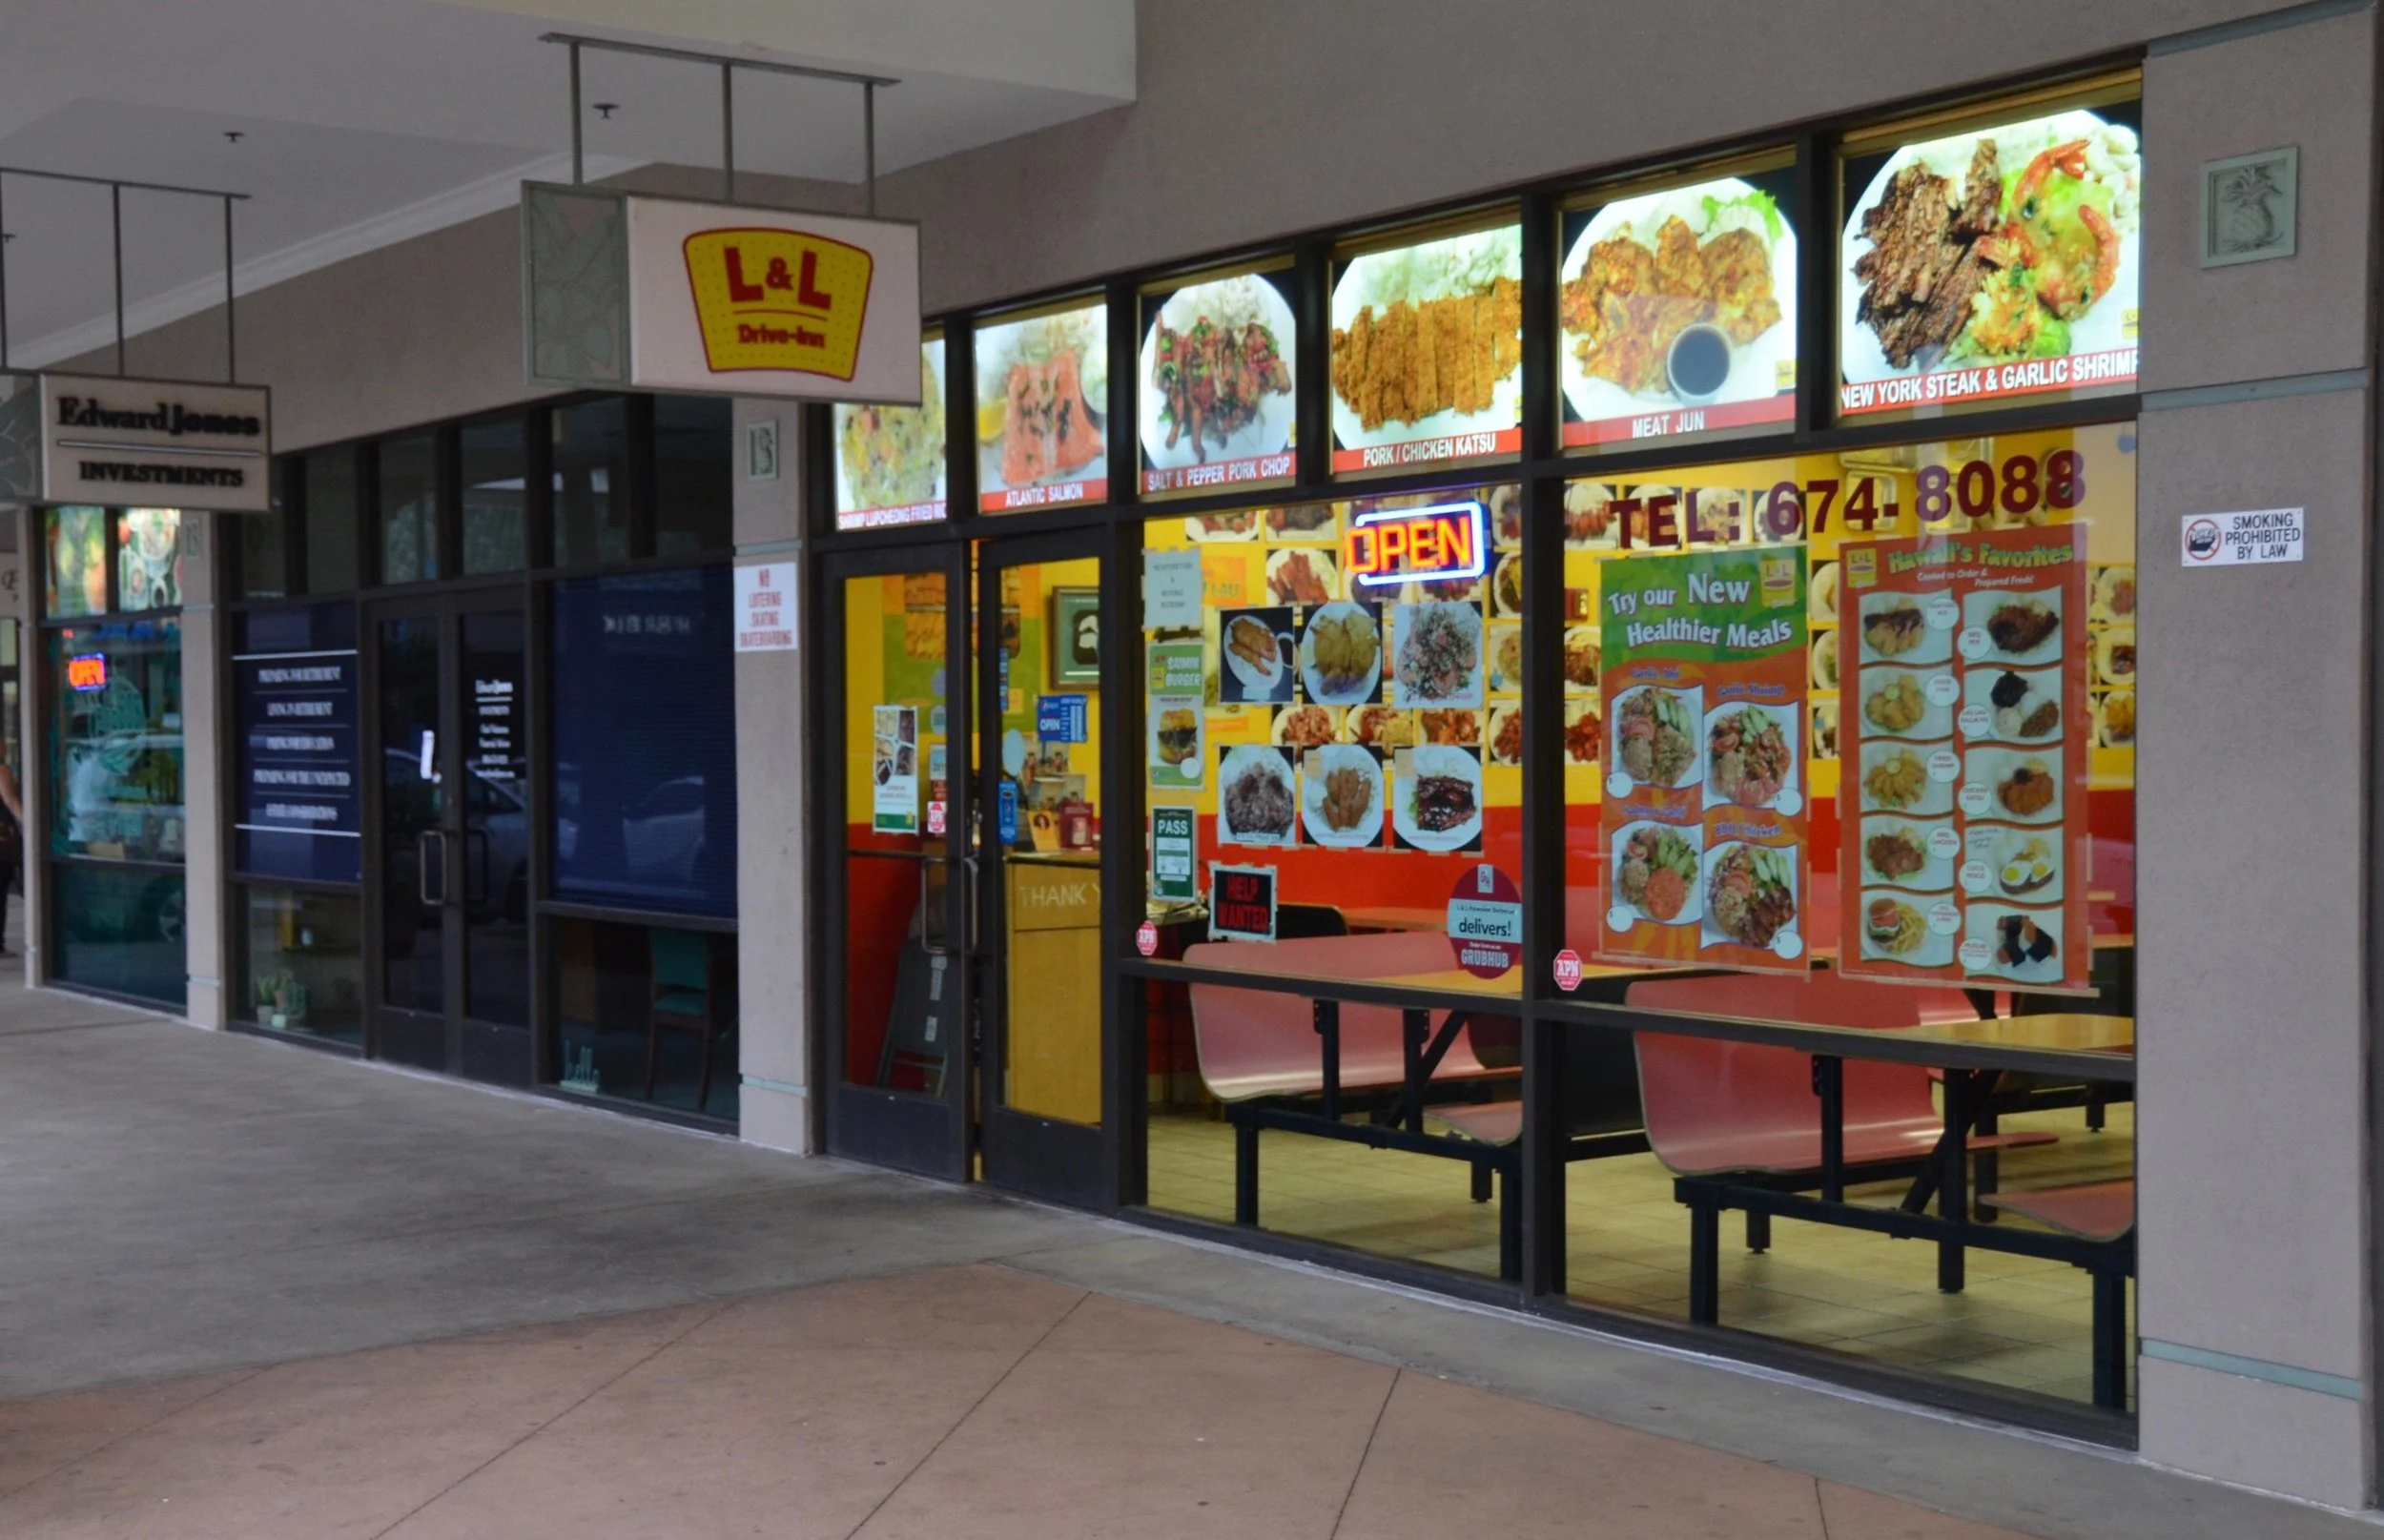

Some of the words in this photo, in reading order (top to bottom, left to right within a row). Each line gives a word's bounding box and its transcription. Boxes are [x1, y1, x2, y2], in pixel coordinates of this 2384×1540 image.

[725, 246, 831, 310] L&L
[1841, 385, 1874, 409] NEW
[1878, 378, 1922, 404] YORK
[1925, 371, 1983, 399] STEAK
[1985, 369, 1999, 391] &
[2002, 359, 2067, 388] GARLIC
[57, 396, 168, 431] Edward
[168, 403, 260, 436] Jones
[1633, 416, 1672, 439] MEAT
[1675, 411, 1704, 433] JUN
[1364, 447, 1393, 467] PORK
[1396, 445, 1401, 463] /
[1403, 439, 1453, 462] CHICKEN
[1455, 432, 1496, 456] KATSU
[79, 461, 243, 487] INVESTMENTS
[1148, 471, 1172, 491] SALT
[1176, 470, 1183, 487] &
[1187, 465, 1224, 486] PEPPER
[1229, 461, 1258, 481] PORK
[1261, 456, 1290, 477] CHOP
[1006, 486, 1045, 507] ATLANTIC
[1049, 483, 1083, 502] SALMON
[1610, 489, 1740, 550] TEL:
[2232, 512, 2294, 529] SMOKING
[1345, 515, 1472, 573] OPEN
[2225, 528, 2300, 545] PROHIBITED
[1887, 542, 1973, 573] Hawaii's
[1979, 541, 2073, 568] Favorites
[2237, 546, 2253, 560] BY
[2260, 544, 2288, 558] LAW
[758, 567, 770, 587] NO
[1917, 571, 1945, 582] Cooked
[1957, 568, 1980, 579] Order
[1974, 576, 2009, 588] Prepared
[2010, 575, 2035, 585] Fresh!
[748, 591, 781, 608] LOITERING
[1608, 591, 1636, 615] Try
[1643, 587, 1677, 606] our
[1687, 572, 1751, 604] New
[1626, 618, 1721, 647] Healthier
[1726, 619, 1793, 648] Meals
[1165, 672, 1201, 687] BURGER
[1039, 718, 1060, 732] OPEN
[1158, 820, 1188, 835] PASS
[1018, 883, 1087, 908] THANK
[1227, 874, 1260, 901] HELP
[1218, 902, 1269, 932] WANTED
[1459, 917, 1511, 936] delivers!
[1460, 948, 1510, 969] GRUBHUB
